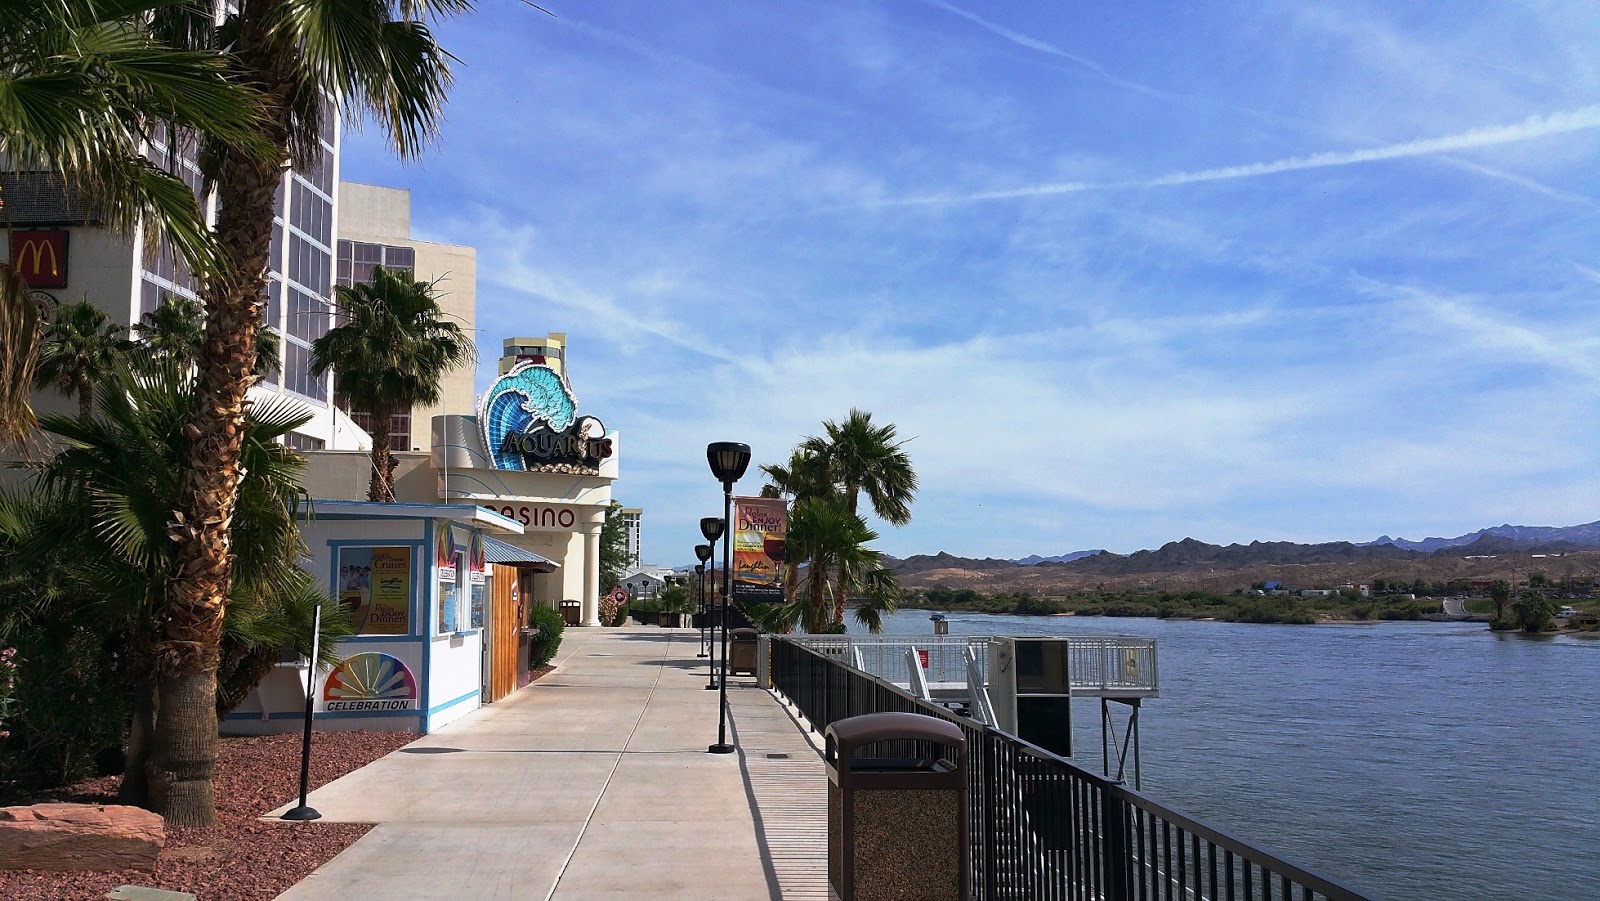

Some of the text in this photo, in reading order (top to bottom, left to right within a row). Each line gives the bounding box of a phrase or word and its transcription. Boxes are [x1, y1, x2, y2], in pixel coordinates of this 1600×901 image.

[483, 504, 575, 528] ASINO
[752, 516, 781, 525] ENJOY
[374, 559, 407, 569] Cruises
[738, 560, 770, 573] Laughlin
[327, 700, 409, 711] CELEBRATION
